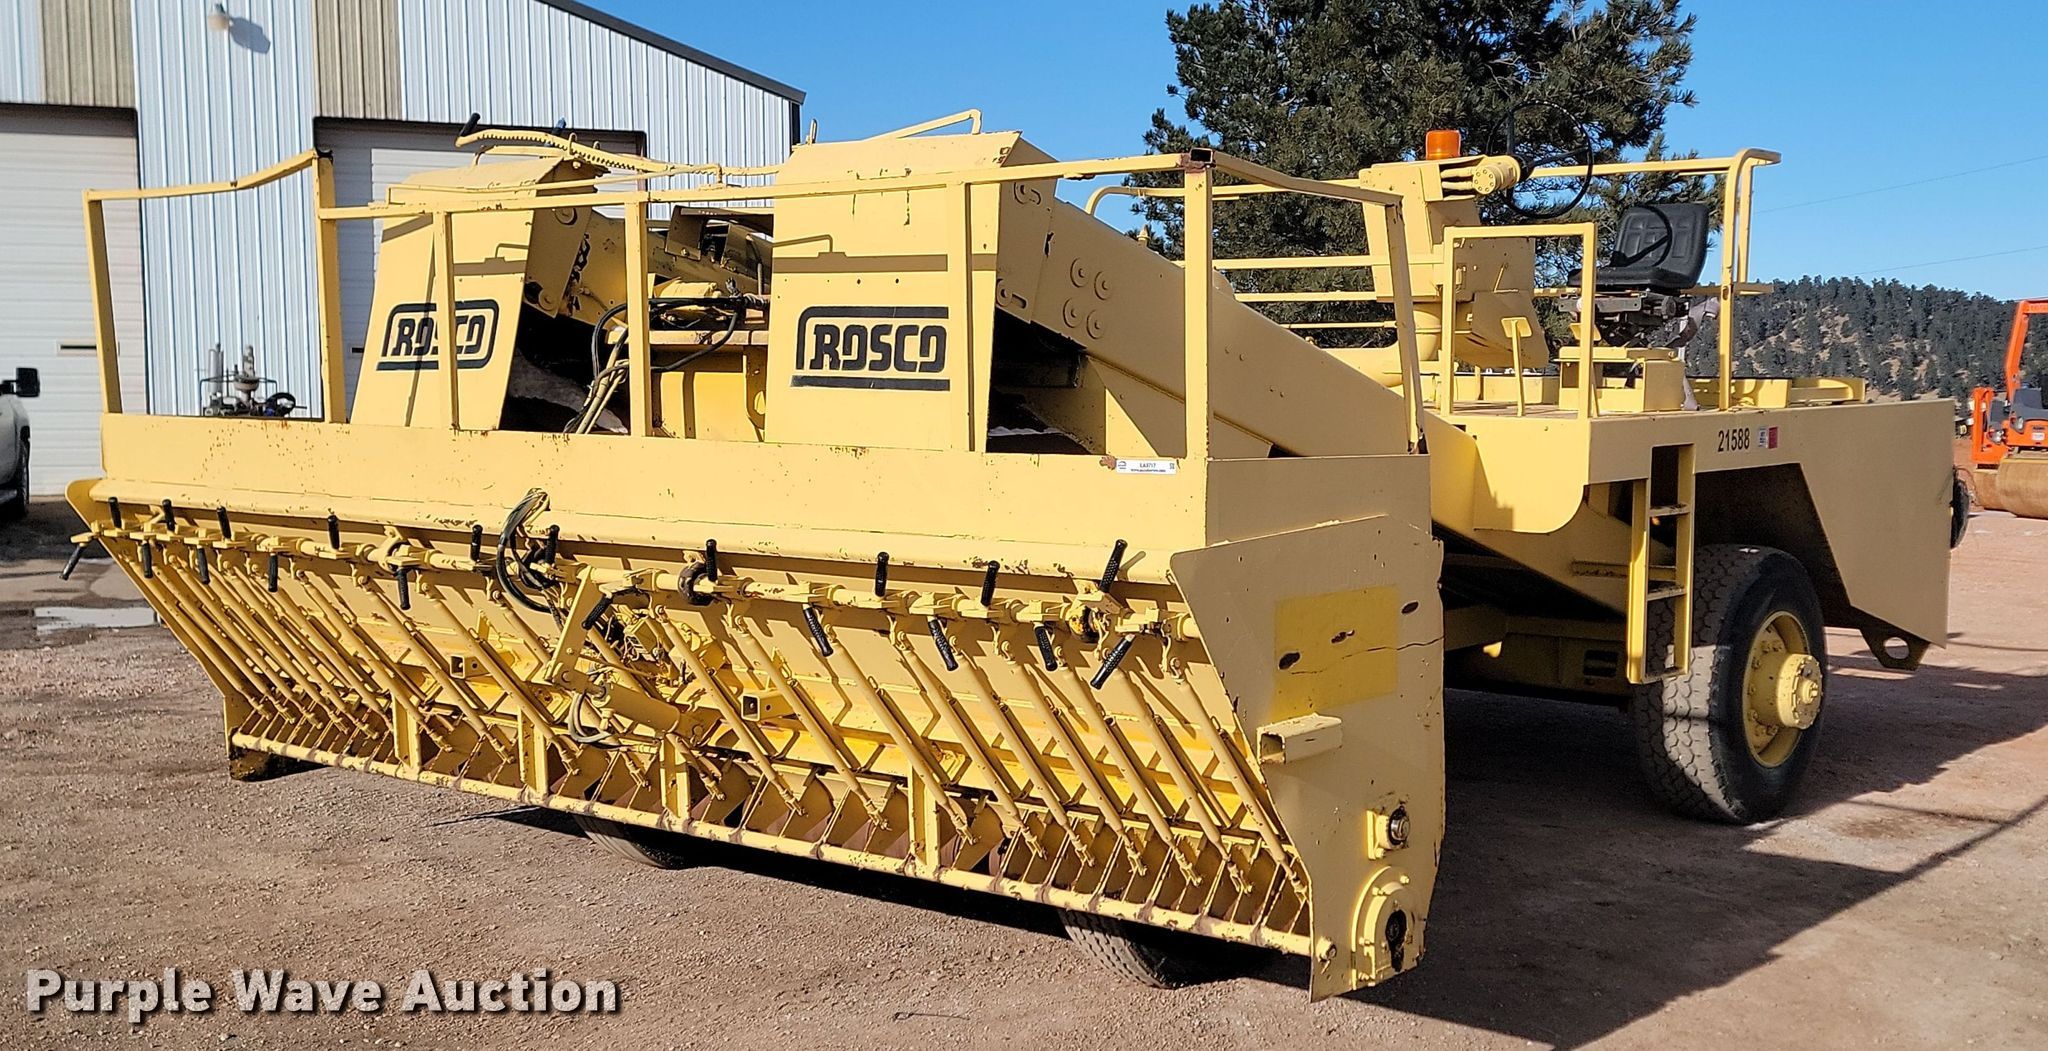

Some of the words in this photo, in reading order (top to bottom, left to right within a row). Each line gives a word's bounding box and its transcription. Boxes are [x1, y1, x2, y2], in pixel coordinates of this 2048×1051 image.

[391, 315, 486, 356] ROCO
[809, 323, 947, 373] ROSCO
[1717, 427, 1751, 453] 21588
